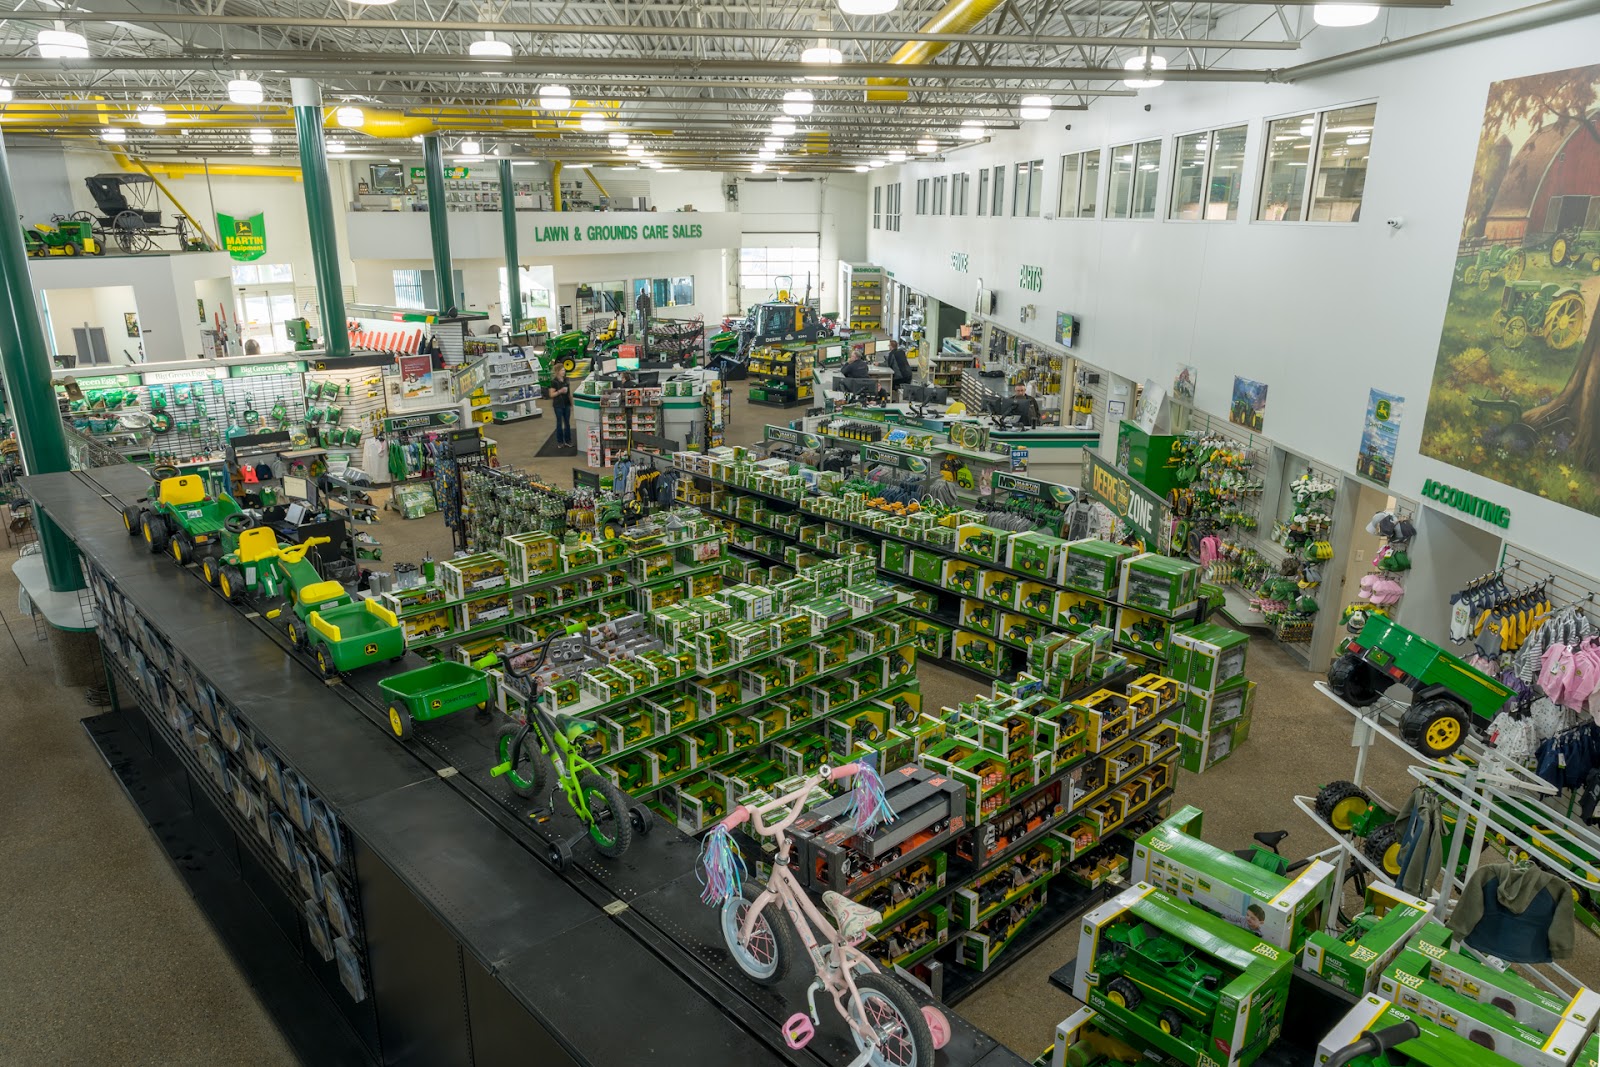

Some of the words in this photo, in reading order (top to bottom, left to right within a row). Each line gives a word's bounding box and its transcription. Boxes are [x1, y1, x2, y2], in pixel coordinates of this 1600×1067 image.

[535, 226, 569, 242] LAWN
[574, 226, 582, 241] &
[587, 225, 638, 241] GROUNDS
[642, 225, 668, 239] CARE
[672, 224, 703, 239] SALES
[226, 236, 263, 245] MARTIN
[227, 244, 264, 252] Equipment
[1019, 264, 1043, 293] PARTS
[241, 366, 252, 374] Big
[253, 365, 273, 373] Green
[274, 364, 288, 372] Egg
[155, 373, 168, 381] Big
[169, 371, 187, 380] Green
[188, 370, 205, 378] Egg
[1093, 464, 1118, 506] DEERE
[1128, 489, 1154, 535] ZONE
[1421, 478, 1511, 530] ACCOUNTING
[459, 691, 478, 701] DEERE
[1155, 891, 1170, 901] S690
[1390, 1007, 1410, 1020] S690
